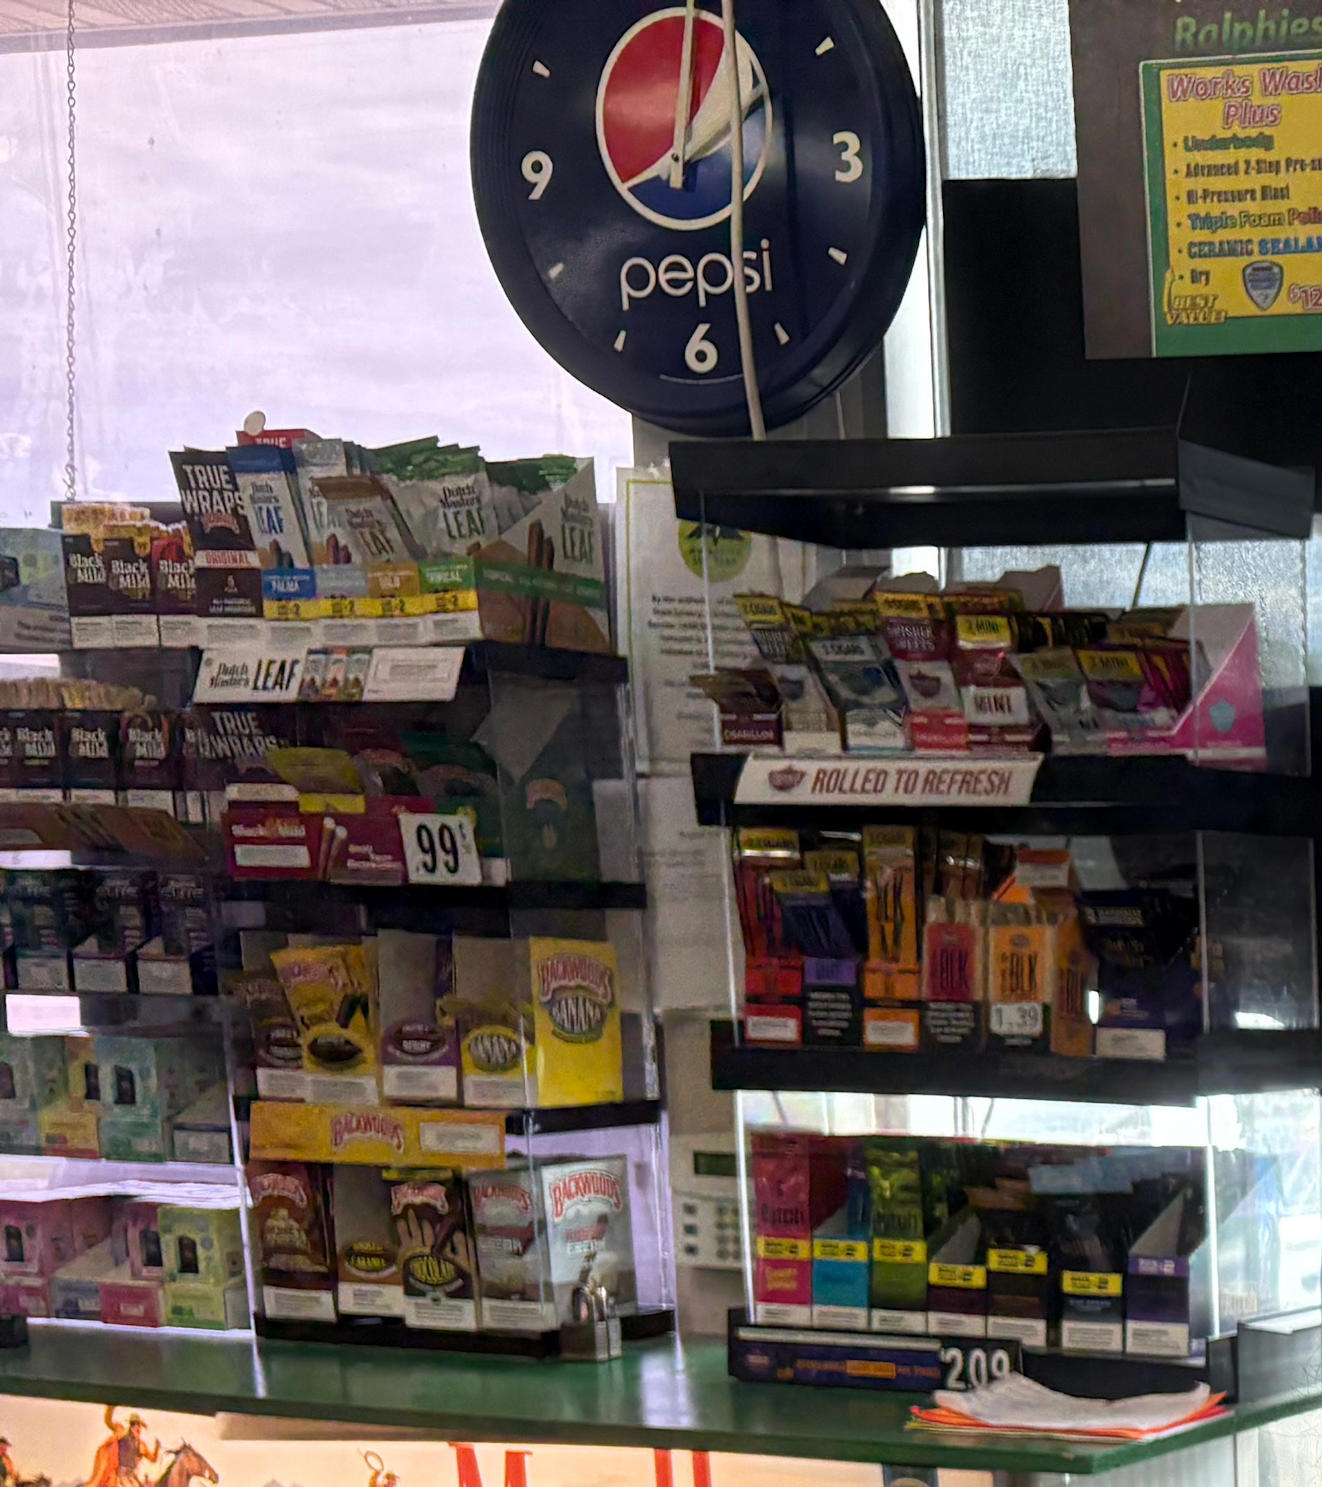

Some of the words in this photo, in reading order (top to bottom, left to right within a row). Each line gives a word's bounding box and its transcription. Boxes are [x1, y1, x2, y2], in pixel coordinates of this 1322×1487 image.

[1167, 70, 1252, 101] Works
[1222, 102, 1281, 128] Plus
[832, 132, 863, 183] 3
[521, 151, 553, 199] 9
[1189, 211, 1234, 231] Triple
[1238, 209, 1283, 229] Foam
[1187, 239, 1254, 259] CERAMIC
[620, 238, 772, 310] pepsi
[1190, 268, 1211, 287] Dry
[685, 323, 718, 374] 6
[182, 465, 229, 489] TRUE
[443, 508, 486, 541] LEAF
[253, 660, 300, 691] LEAF
[211, 711, 260, 735] TRUE
[811, 769, 888, 795] ROLLED
[899, 769, 919, 794] TO
[922, 768, 1011, 795] REFRESH
[331, 1112, 404, 1152] BACKWOODS
[552, 1169, 622, 1221] BACKWOODS
